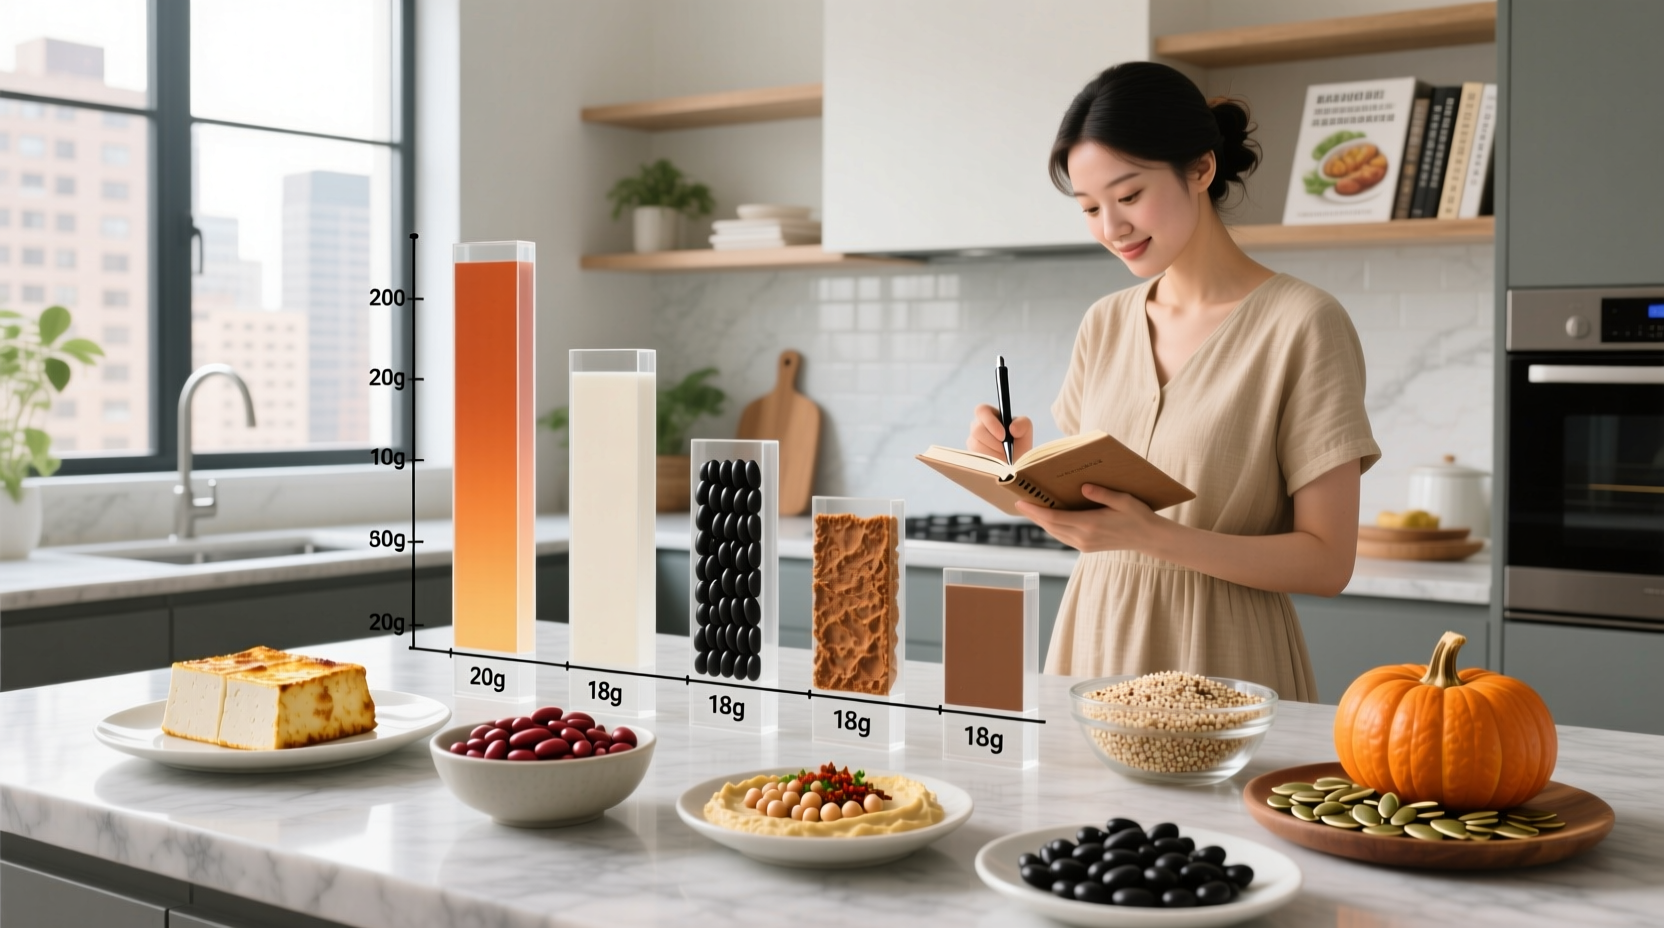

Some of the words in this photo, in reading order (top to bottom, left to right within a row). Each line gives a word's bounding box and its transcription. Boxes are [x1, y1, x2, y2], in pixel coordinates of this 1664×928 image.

[370, 288, 405, 306] 200
[369, 368, 405, 391] 20g
[370, 448, 405, 470] 10g
[369, 612, 405, 636] 20g
[470, 666, 506, 693] 20g
[587, 680, 623, 707] 18g
[708, 694, 745, 722] 18g
[833, 709, 871, 738] 18g
[964, 725, 1004, 755] 18g
